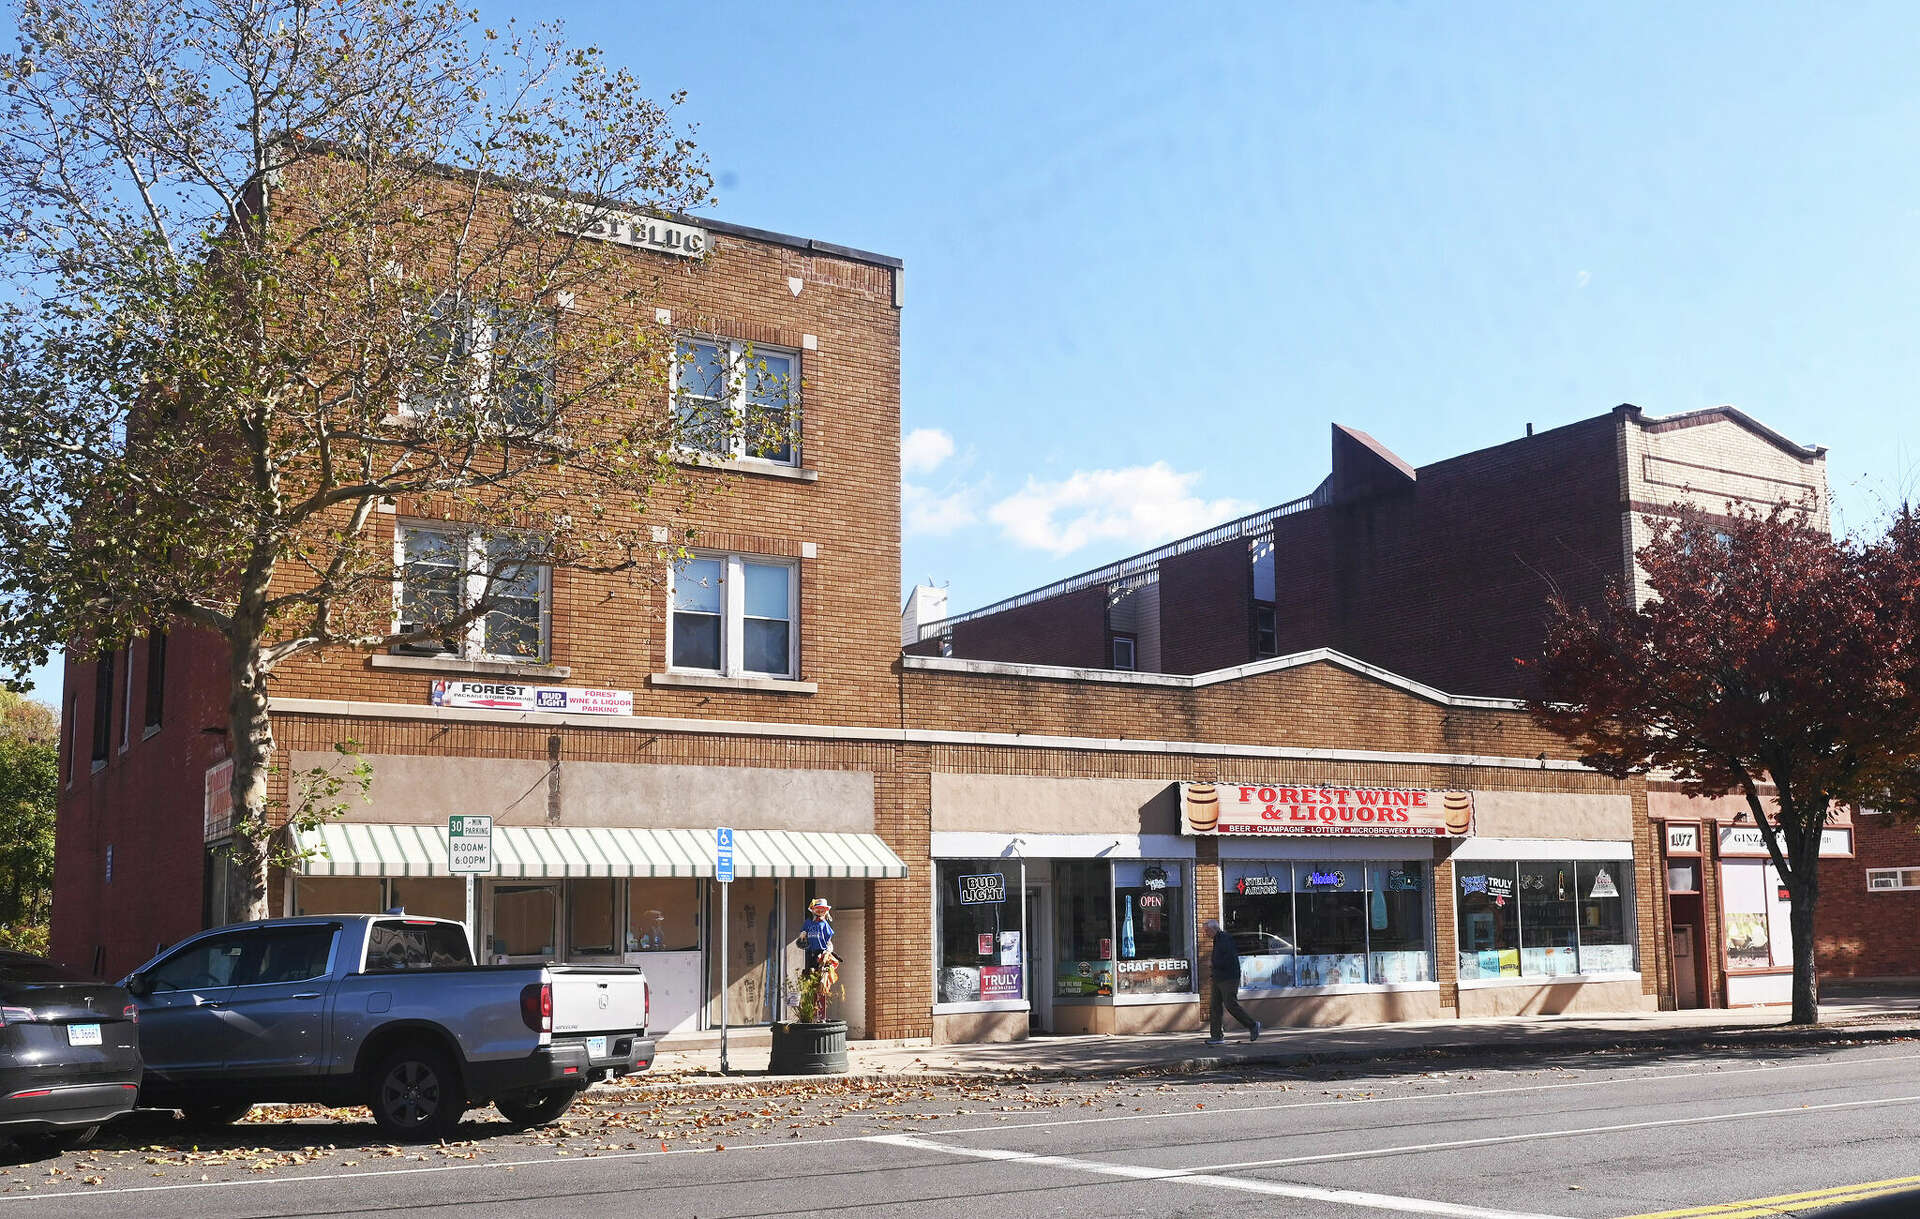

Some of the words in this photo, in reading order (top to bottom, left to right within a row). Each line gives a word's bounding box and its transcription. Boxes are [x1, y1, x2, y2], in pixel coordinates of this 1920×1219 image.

[462, 683, 526, 696] FOREST
[584, 690, 617, 698] FOREST
[541, 692, 562, 700] BUD
[569, 697, 590, 705] WINE
[537, 698, 566, 707] LIGHT
[582, 705, 619, 713] PARKING
[1238, 786, 1351, 806] FOREST
[1355, 789, 1428, 807] WINE
[1261, 804, 1283, 821] &
[1289, 805, 1410, 825] LIQUORS
[451, 820, 462, 832] 30
[465, 827, 489, 835] PARKING
[1256, 825, 1306, 833] CHAMPAGNE
[1311, 826, 1345, 834] LOTTERY
[1734, 834, 1764, 843] GINZ
[455, 856, 486, 864] 6:00PM
[967, 876, 997, 889] BUD
[1487, 877, 1513, 889] TRULY
[963, 887, 1004, 901] LIGHT
[1140, 896, 1162, 907] OPEN
[1118, 961, 1155, 973] CRAFT
[1158, 960, 1188, 971] BEER
[983, 973, 1018, 986] TRULY
